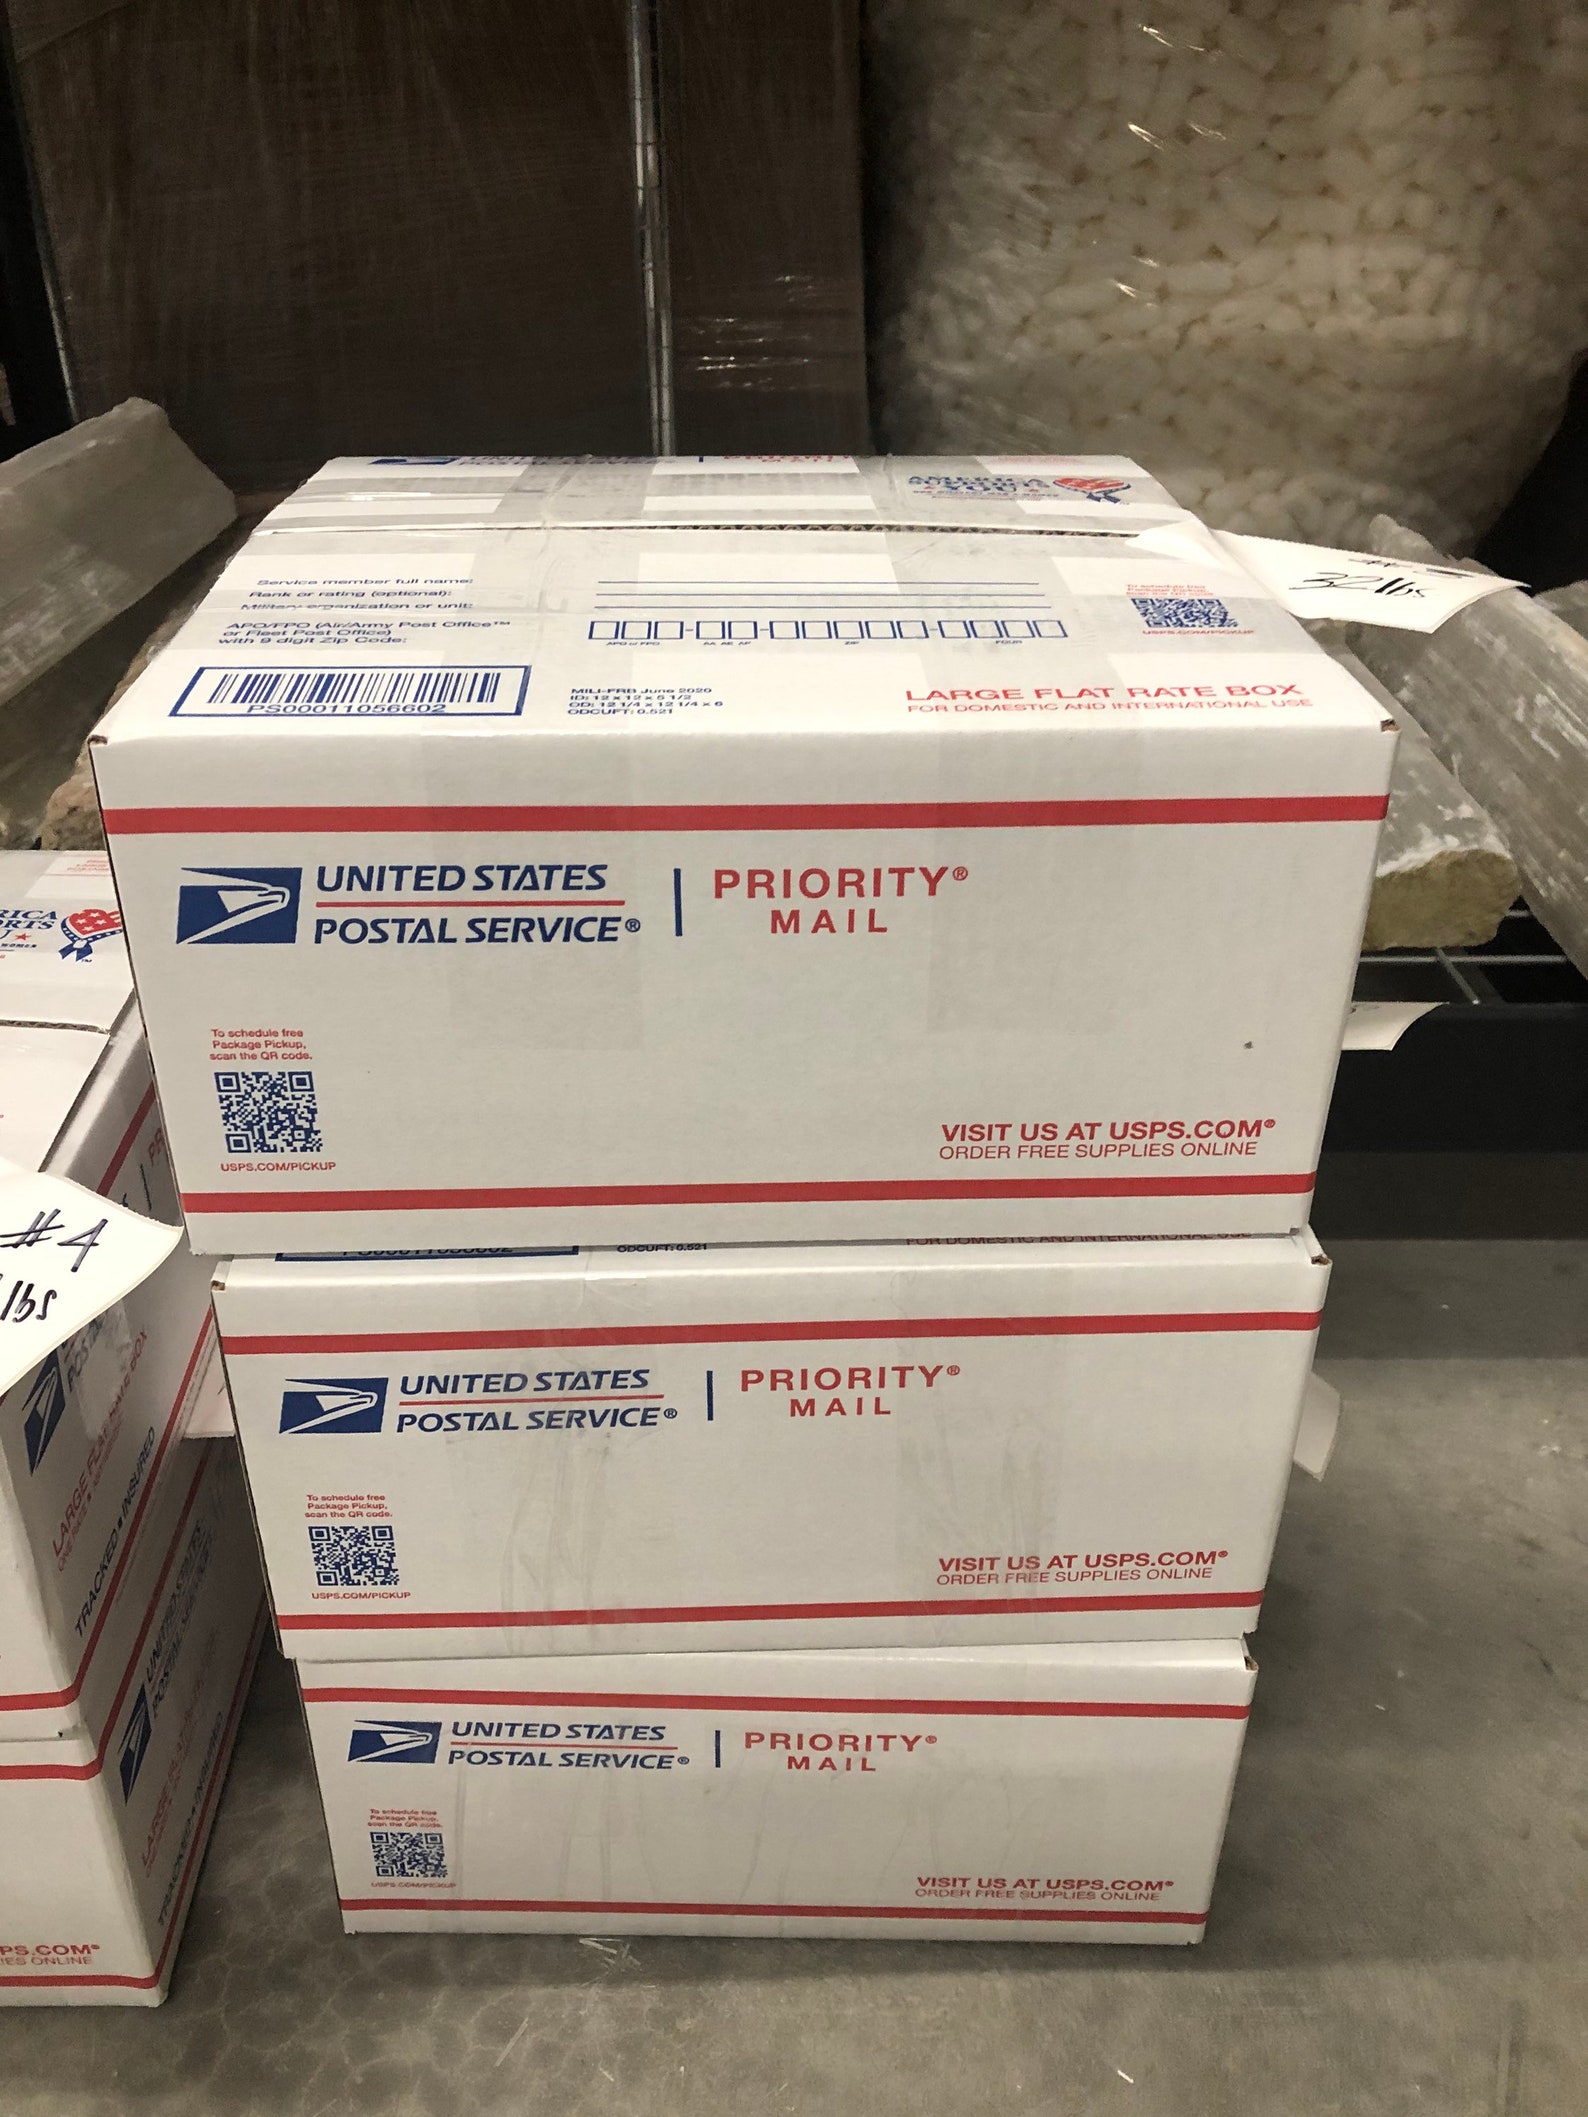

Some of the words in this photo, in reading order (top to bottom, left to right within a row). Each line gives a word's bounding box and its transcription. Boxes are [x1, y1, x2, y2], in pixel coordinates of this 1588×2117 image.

[322, 578, 391, 586] member
[395, 577, 419, 585] full
[318, 590, 366, 599] rating
[371, 590, 452, 599] (optional):
[226, 622, 311, 630] APO/FPO
[315, 622, 394, 631] (Air/Army
[398, 621, 437, 629] Post
[336, 629, 392, 638] Office)
[218, 637, 254, 645] with
[277, 637, 315, 646] digit
[320, 637, 349, 645] Zip
[354, 637, 408, 645] Code:
[905, 688, 1024, 701] LARGE
[1034, 687, 1115, 700] FLAT
[1126, 686, 1218, 698] RATE
[1225, 684, 1304, 697] BOX
[247, 704, 447, 714] PS00011056602
[907, 704, 949, 713] FOR
[954, 703, 1059, 712] DOMESTIC
[1064, 702, 1106, 711] AND
[1111, 701, 1268, 710] INTERNATIONAL
[1272, 699, 1313, 708] USE
[317, 865, 467, 893] UNITED
[472, 864, 609, 892] STATES
[770, 908, 888, 934] MAIL
[313, 917, 459, 945] POSTAL
[211, 1029, 226, 1038] To
[228, 1028, 280, 1038] schedule
[281, 1028, 304, 1038] free
[212, 1040, 262, 1051] Package
[210, 1052, 237, 1060] scan
[239, 1051, 258, 1060] the
[260, 1050, 279, 1060] QR
[281, 1051, 313, 1060] code.
[941, 1123, 1012, 1142] VISIT
[1019, 1122, 1059, 1142] US
[1065, 1122, 1103, 1141] AT
[939, 1145, 1011, 1160] ORDER
[1017, 1145, 1070, 1159] FREE
[1074, 1143, 1175, 1158] SUPPLIES
[1180, 1141, 1258, 1157] ONLINE
[220, 1161, 337, 1172] USPS.COM/PICKUP
[399, 1372, 529, 1396] UNITED
[532, 1369, 650, 1393] STATES
[790, 1396, 891, 1418] MAIL
[396, 1410, 520, 1434] POSTAL
[307, 1502, 349, 1511] Package
[52, 1471, 88, 1558] LARGE
[348, 1510, 363, 1518] QR
[366, 1510, 393, 1518] code.
[75, 1527, 118, 1638] TRACKED
[120, 1426, 153, 1518] INSURED
[938, 1557, 1001, 1572] VISIT
[1007, 1556, 1041, 1571] US
[1046, 1554, 1079, 1570] AT
[936, 1573, 999, 1586] ORDER
[1004, 1571, 1050, 1584] FREE
[1054, 1569, 1141, 1583] SUPPLIES
[1146, 1567, 1213, 1580] ONLINE
[311, 1592, 411, 1600] USPS.COM/PICKUP
[451, 1721, 562, 1739] UNITED
[565, 1723, 667, 1741] STATES
[448, 1750, 553, 1767] POSTAL
[787, 1756, 877, 1772] MAIL
[917, 1876, 971, 1888] VISIT
[977, 1877, 1008, 1889] US
[1013, 1878, 1041, 1889] AT
[915, 1888, 970, 1898] ORDER
[975, 1889, 1015, 1899] FREE
[1020, 1890, 1097, 1900] SUPPLIES
[1101, 1891, 1161, 1901] ONLINE
[31, 1956, 92, 1965] ONLINE
